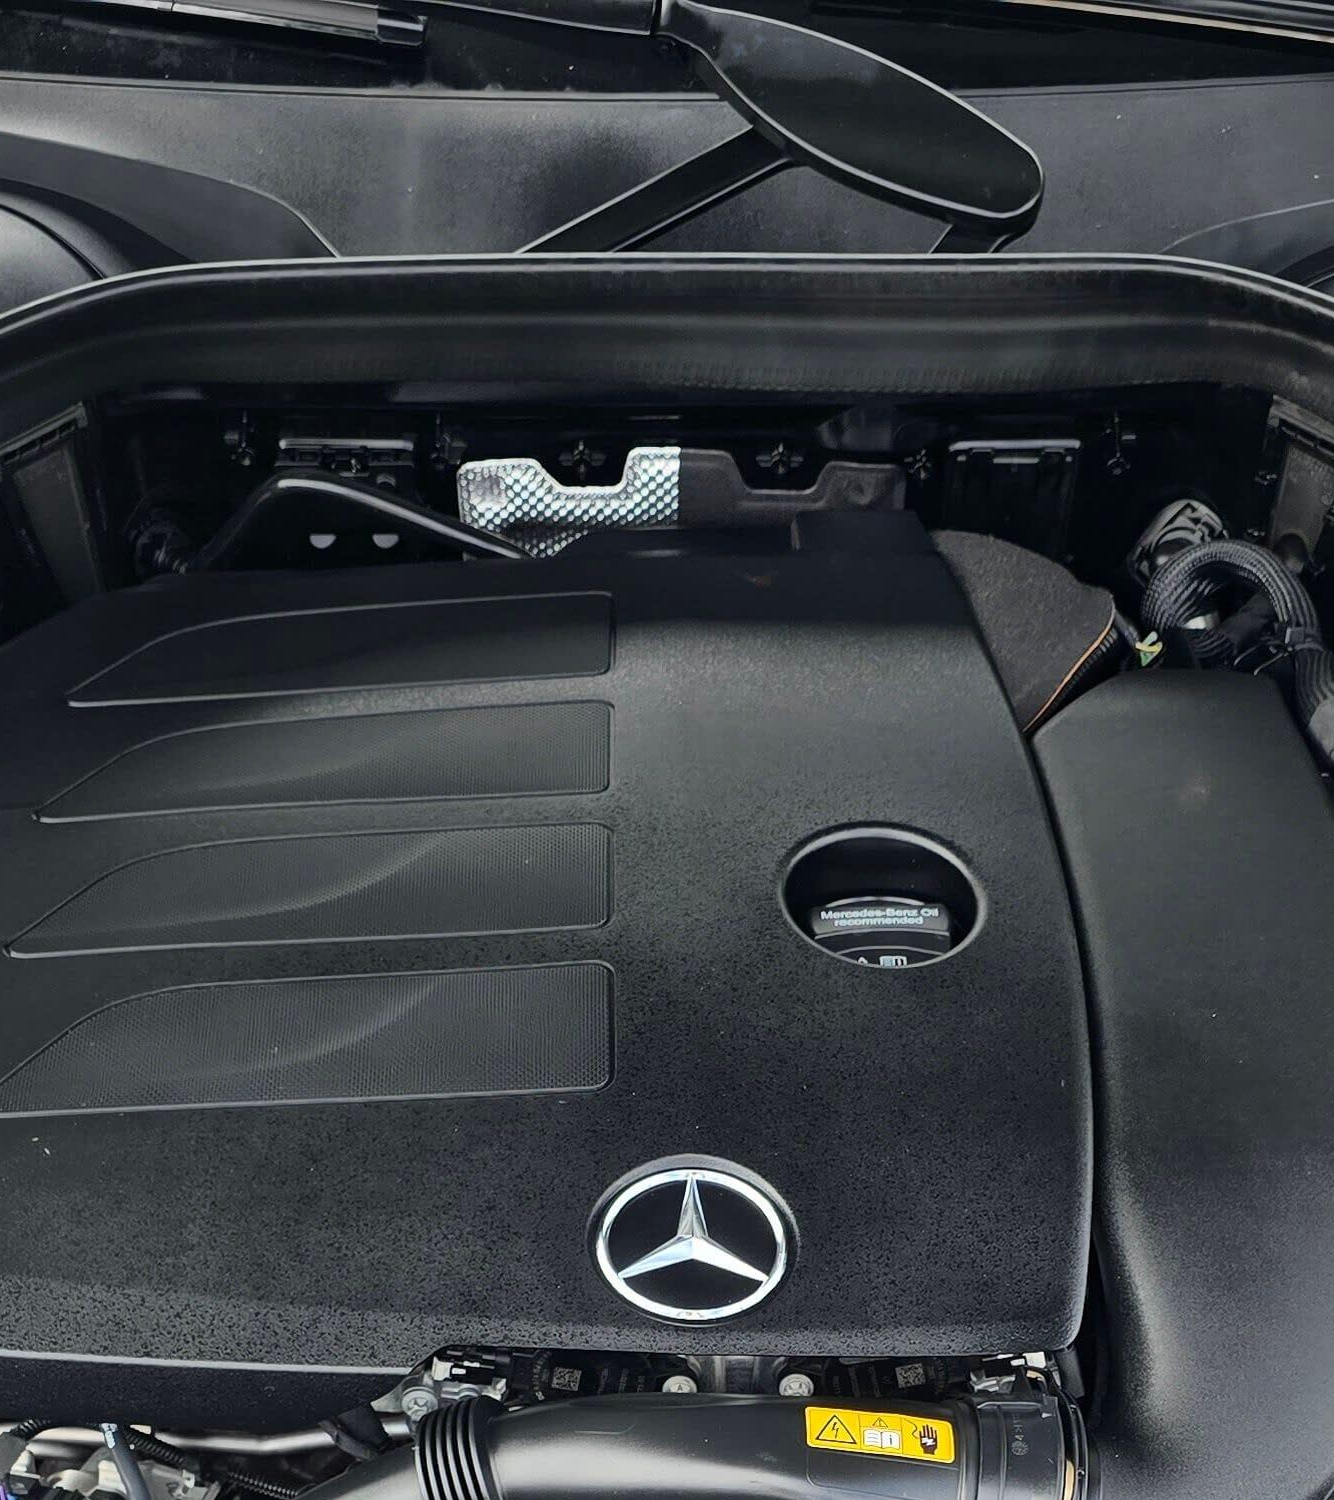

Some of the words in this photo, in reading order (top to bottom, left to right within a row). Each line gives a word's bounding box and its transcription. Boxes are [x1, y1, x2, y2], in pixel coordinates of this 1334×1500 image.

[820, 908, 918, 920] Mercedes-Benz
[920, 907, 939, 918] Oil
[834, 916, 924, 927] recommended
